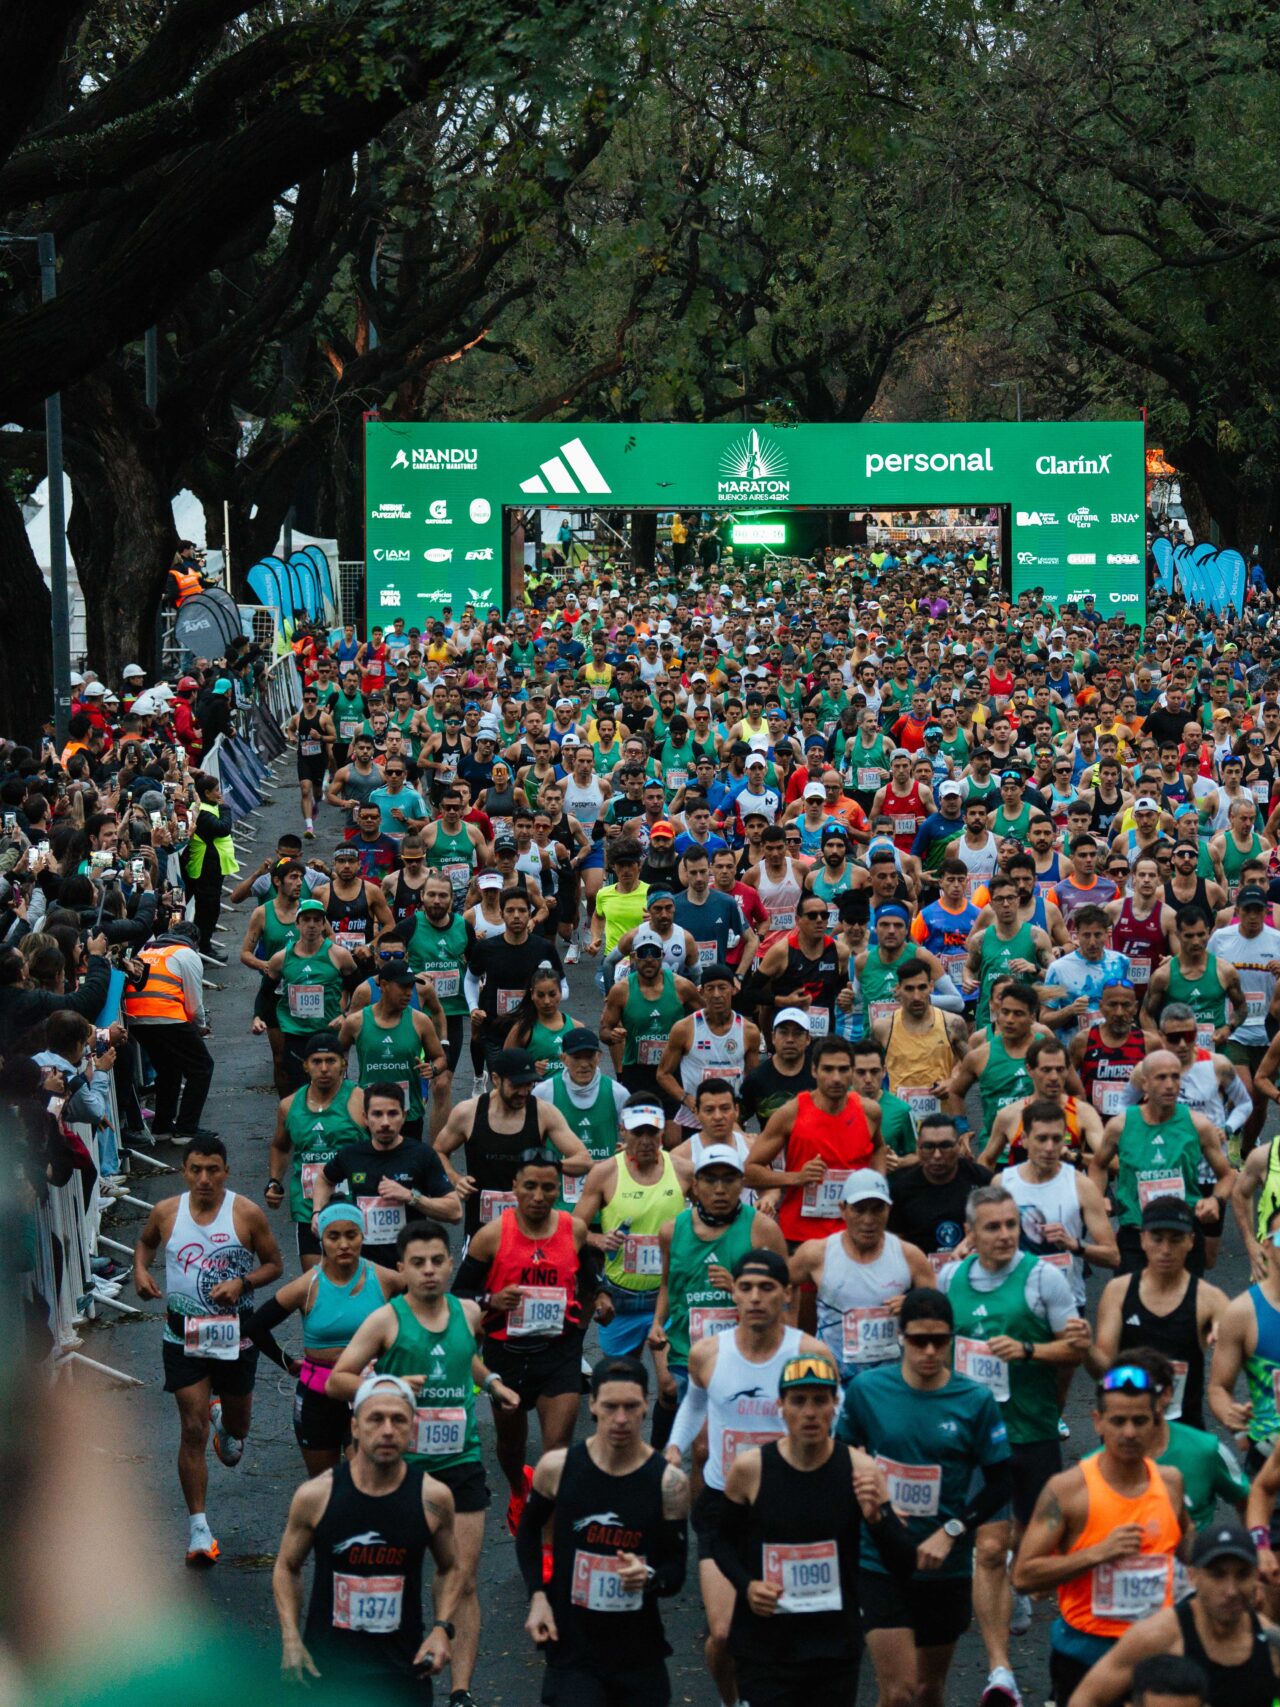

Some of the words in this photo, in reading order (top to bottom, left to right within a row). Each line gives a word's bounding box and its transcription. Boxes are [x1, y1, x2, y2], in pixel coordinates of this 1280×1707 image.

[412, 449, 477, 463] NANDU
[866, 448, 992, 478] personal
[718, 481, 790, 493] MARATON
[1016, 511, 1042, 526] BA
[386, 549, 411, 558] IAM
[465, 550, 494, 561] ENA
[1067, 593, 1097, 603] RAPTR
[424, 961, 457, 971] persona
[1194, 1010, 1214, 1019] onal
[636, 1033, 670, 1043] person
[365, 1061, 408, 1073] personal
[544, 1062, 563, 1070] erso
[301, 1151, 335, 1163] person
[586, 1146, 608, 1157] onal
[822, 1180, 843, 1200] 157
[483, 1195, 491, 1209] C
[372, 1210, 400, 1226] 1288
[627, 1238, 636, 1254] C
[519, 1268, 556, 1287] KING
[685, 1290, 728, 1305] person
[529, 1303, 559, 1320] 1883
[844, 1313, 854, 1330] C
[862, 1321, 893, 1341] 2419
[971, 1355, 1001, 1378] 1284
[416, 1384, 464, 1398] rsonal
[424, 1424, 460, 1443] 1596
[724, 1434, 735, 1454] C
[893, 1481, 932, 1506] 1089
[587, 1524, 643, 1549] GALGOS
[348, 1545, 407, 1566] GALGOS
[578, 1558, 588, 1582] C
[767, 1550, 779, 1573] C
[790, 1562, 831, 1586] 1090
[337, 1580, 347, 1600] C
[357, 1596, 396, 1619] 1374
